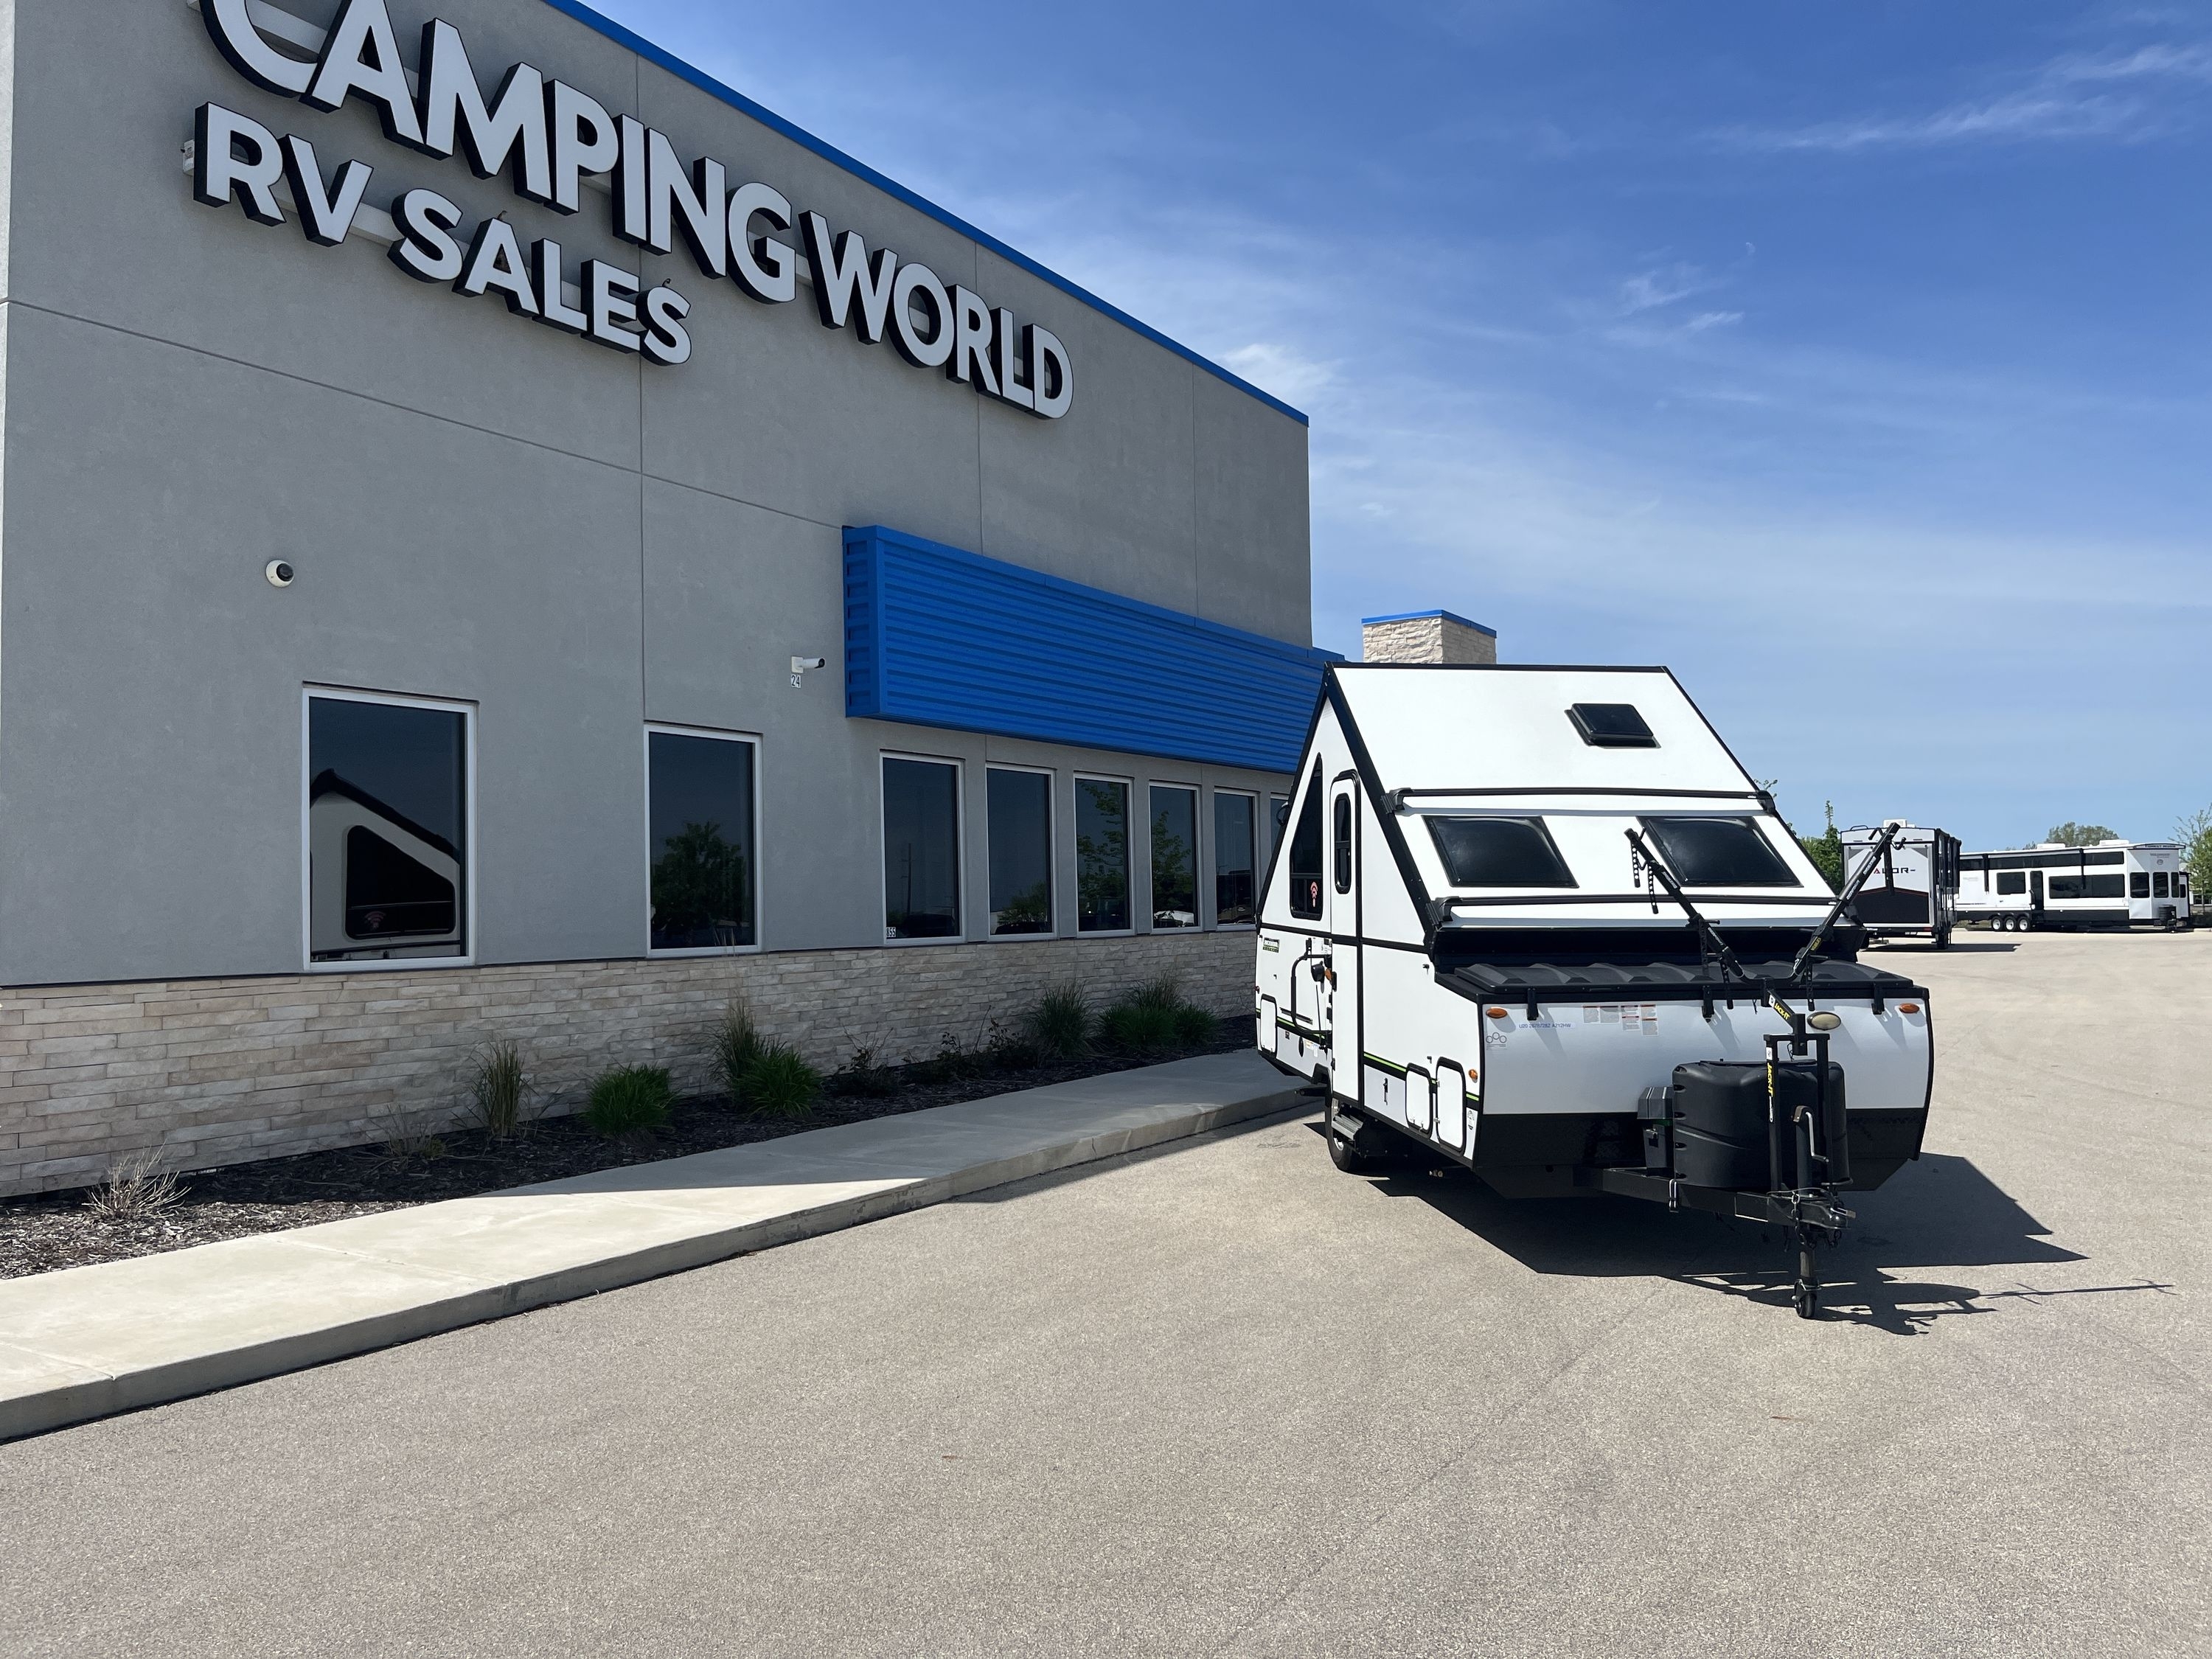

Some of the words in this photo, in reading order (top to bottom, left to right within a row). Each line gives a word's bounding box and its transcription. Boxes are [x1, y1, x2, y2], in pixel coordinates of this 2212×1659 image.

[194, 101, 374, 247] RV
[388, 187, 692, 366] SALES
[204, 0, 796, 305] CAMPING
[799, 209, 1074, 420] WORLD
[791, 675, 801, 687] 24
[1774, 1003, 1790, 1020] JACK-IT
